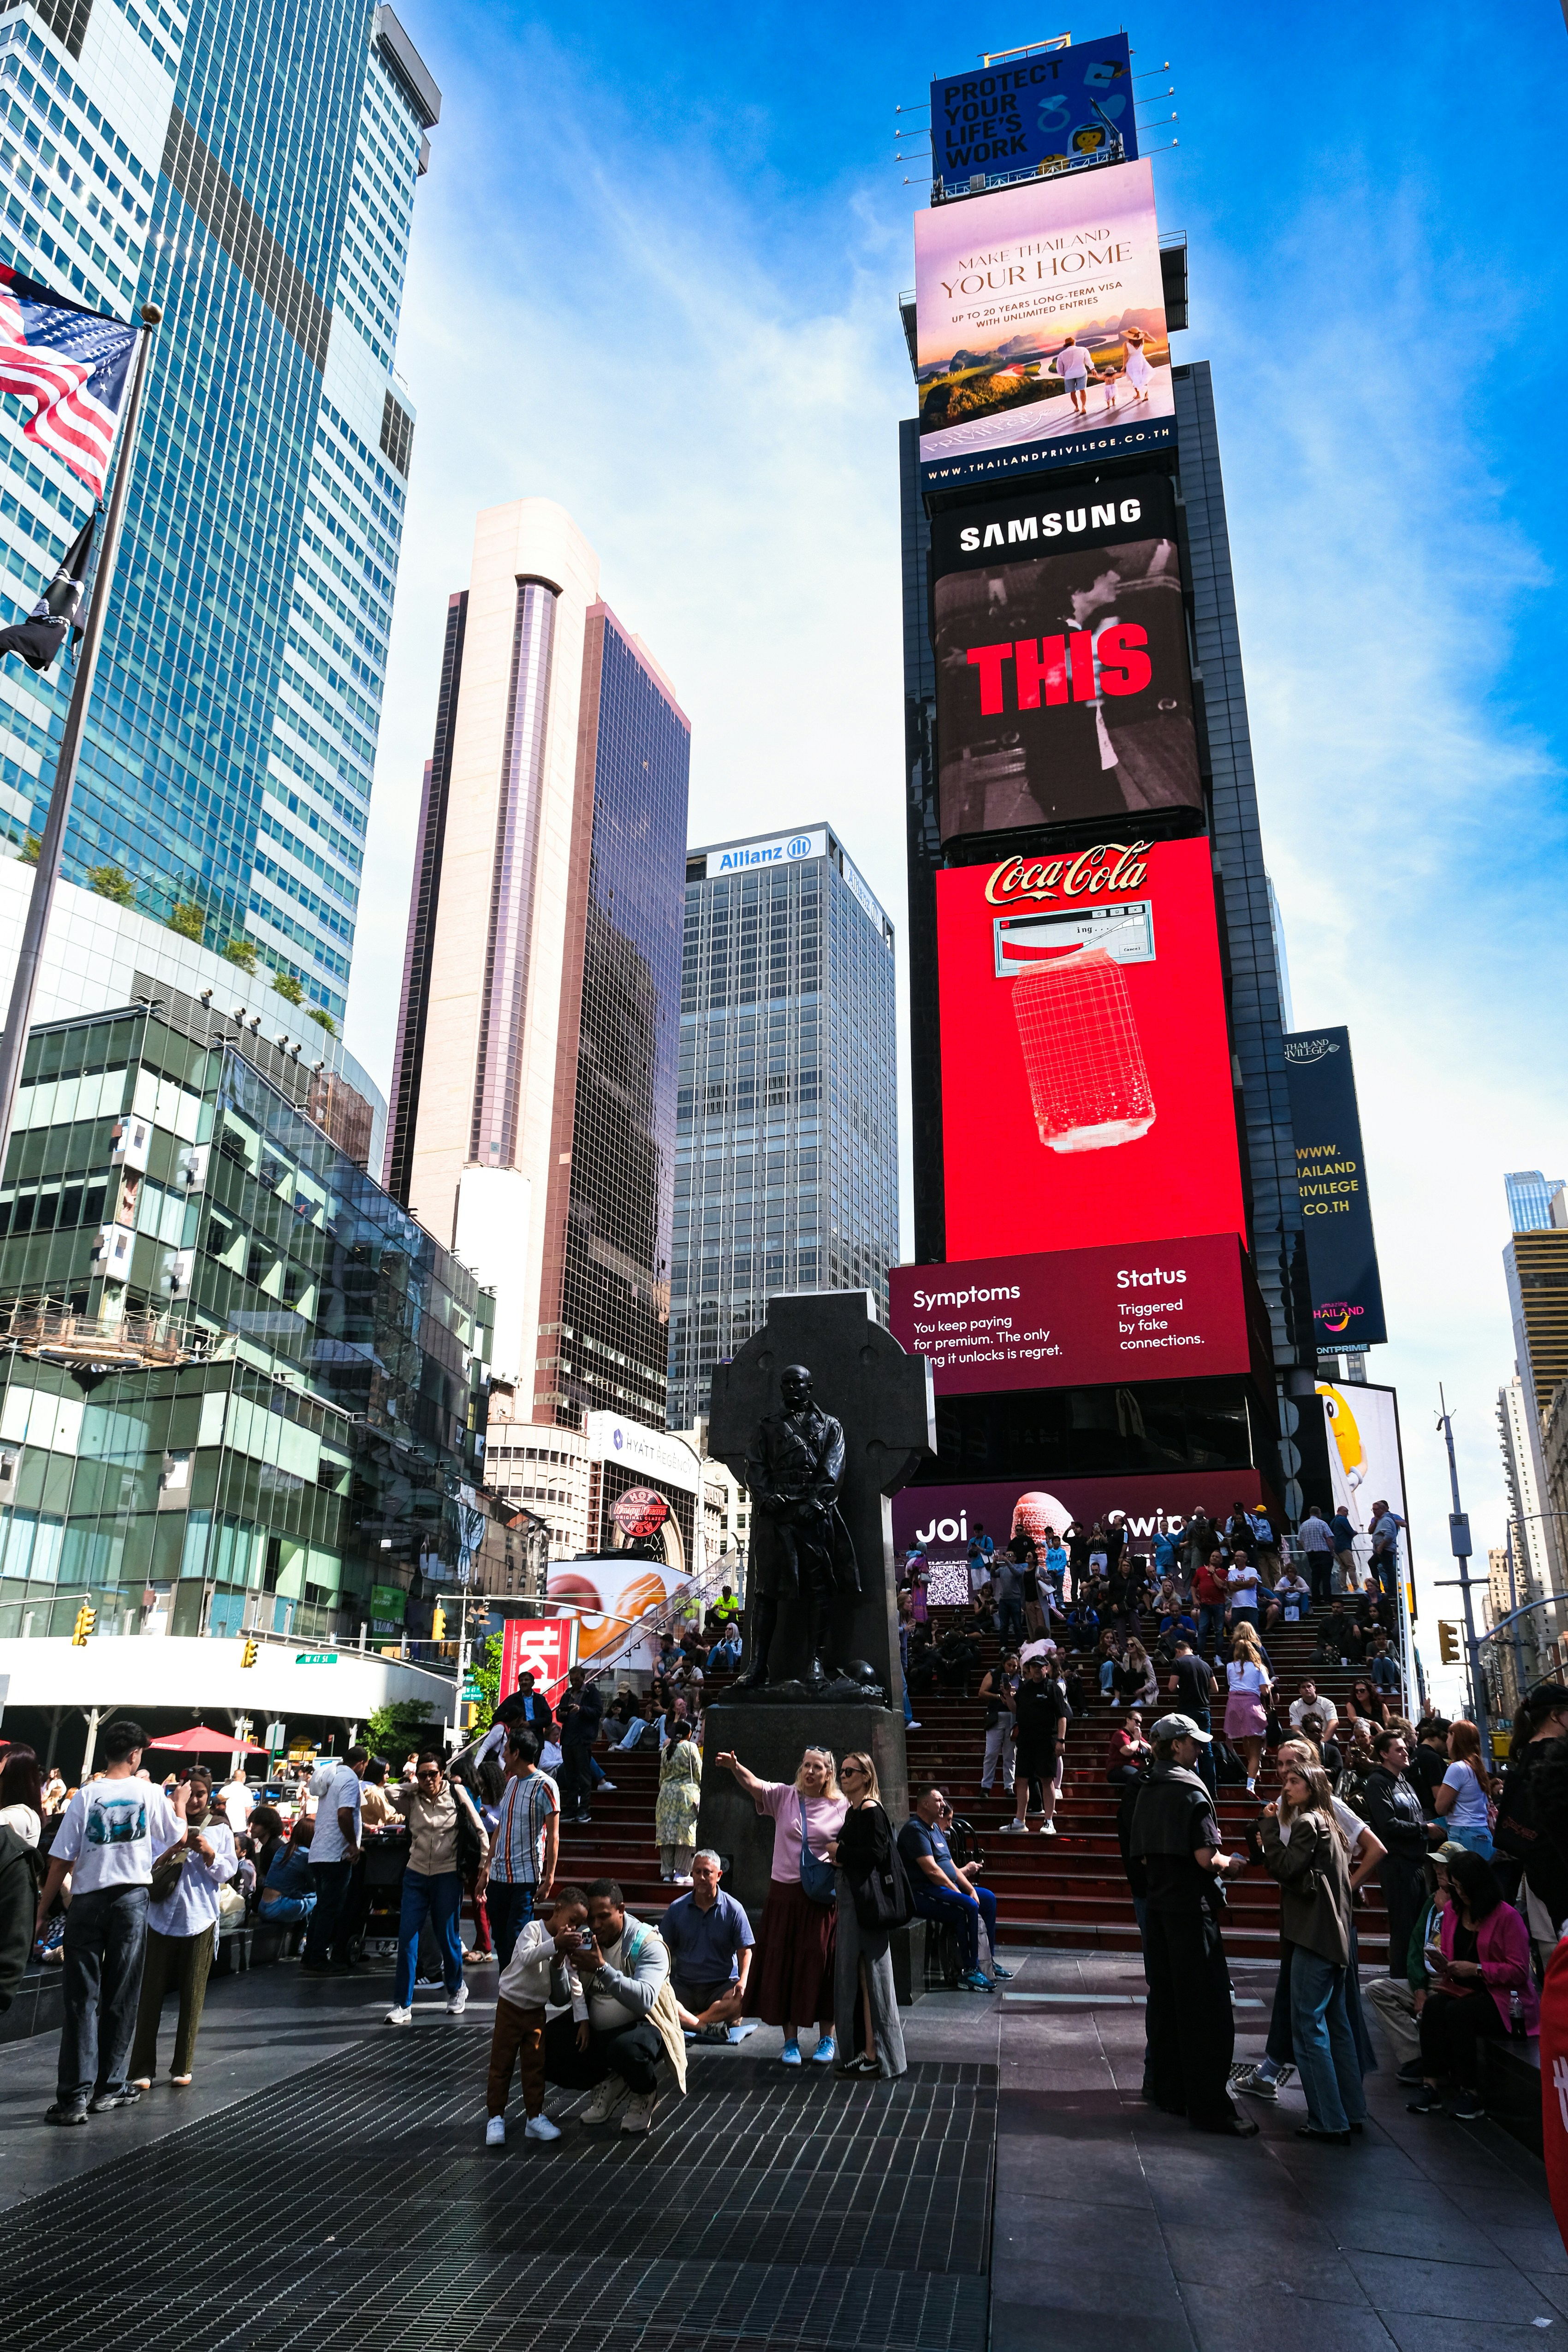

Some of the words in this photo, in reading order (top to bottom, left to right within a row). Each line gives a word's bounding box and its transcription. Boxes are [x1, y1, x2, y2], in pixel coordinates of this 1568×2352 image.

[944, 59, 1063, 106] PROTECT
[944, 94, 1018, 125] YOUR
[946, 113, 1022, 148] LIFE'S
[946, 133, 1028, 169] WORK
[959, 250, 1010, 271] MAKE
[1015, 229, 1110, 258] THAILAND
[940, 266, 1027, 298] YOUR
[1037, 242, 1133, 279] HOME
[967, 312, 980, 320] TO
[984, 308, 995, 316] 20
[999, 301, 1030, 314] YEARS
[1033, 287, 1095, 305] LONG-TERM
[1099, 281, 1123, 291] VISA
[976, 317, 1000, 328] WITH
[1004, 305, 1056, 322] UNLIMITED
[1060, 297, 1098, 310] ENTRIES
[923, 417, 1033, 451] PRIVILEGE
[940, 411, 1033, 439] THAILAND
[928, 428, 1170, 480] WWW.THAILANDPRIVILEGE.CO.TH
[960, 499, 1141, 551] SAMSUNG
[967, 624, 1152, 715] THIS
[719, 846, 783, 871] Allianz
[985, 840, 1154, 905] Coca-Cola
[848, 867, 871, 912] Allianz
[1284, 1039, 1329, 1051] THAILAND
[1284, 1046, 1326, 1058] IVILEGE
[1295, 1145, 1341, 1159] WWW.
[1117, 1267, 1187, 1289] Status
[913, 1286, 1021, 1311] Symptoms
[1117, 1299, 1183, 1317] Triggered
[914, 1323, 935, 1333] You
[938, 1321, 967, 1332] keep
[970, 1316, 1012, 1331] paying
[1119, 1321, 1135, 1335] by
[1138, 1319, 1168, 1331] fake
[914, 1339, 932, 1350] for
[935, 1335, 993, 1351] premium.
[997, 1331, 1021, 1342] The
[1023, 1328, 1050, 1342] only
[1120, 1334, 1205, 1350] connections.
[948, 1353, 956, 1364] it
[959, 1349, 1004, 1363] unlocks
[1008, 1348, 1016, 1359] is
[1020, 1344, 1063, 1360] regret.
[627, 1437, 655, 1460] HYATT
[657, 1450, 692, 1474] REGENCY
[613, 1503, 641, 1516] Krispy
[641, 1504, 668, 1516] Kreme
[630, 1491, 653, 1502] HOT
[628, 1522, 653, 1533] NOW
[1108, 1508, 1206, 1537] Swip
